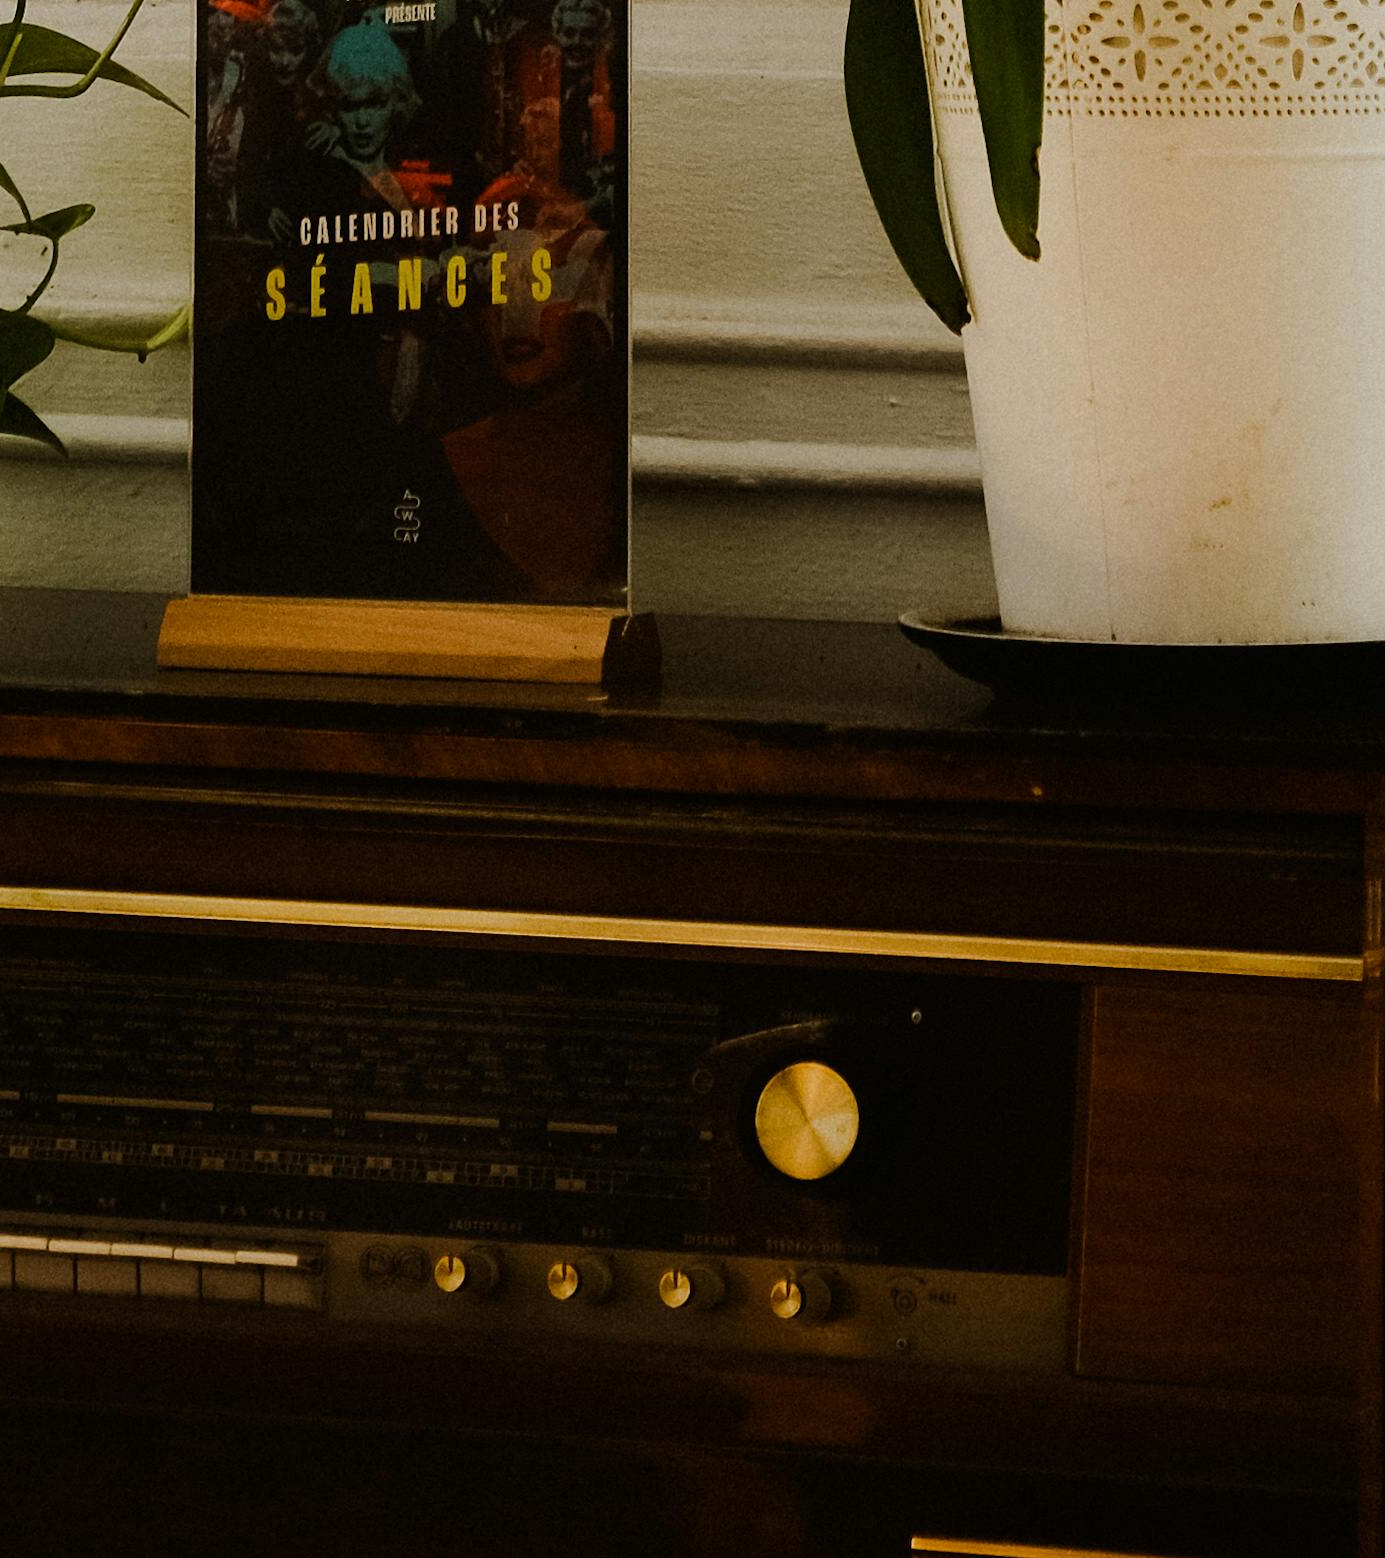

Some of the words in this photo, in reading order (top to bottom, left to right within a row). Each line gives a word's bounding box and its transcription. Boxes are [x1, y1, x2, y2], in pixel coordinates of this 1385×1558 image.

[385, 2, 437, 24] PRÉSENTE
[300, 206, 459, 246] CALENDRIER
[474, 201, 519, 232] DES
[265, 248, 554, 321] SÉANCES
